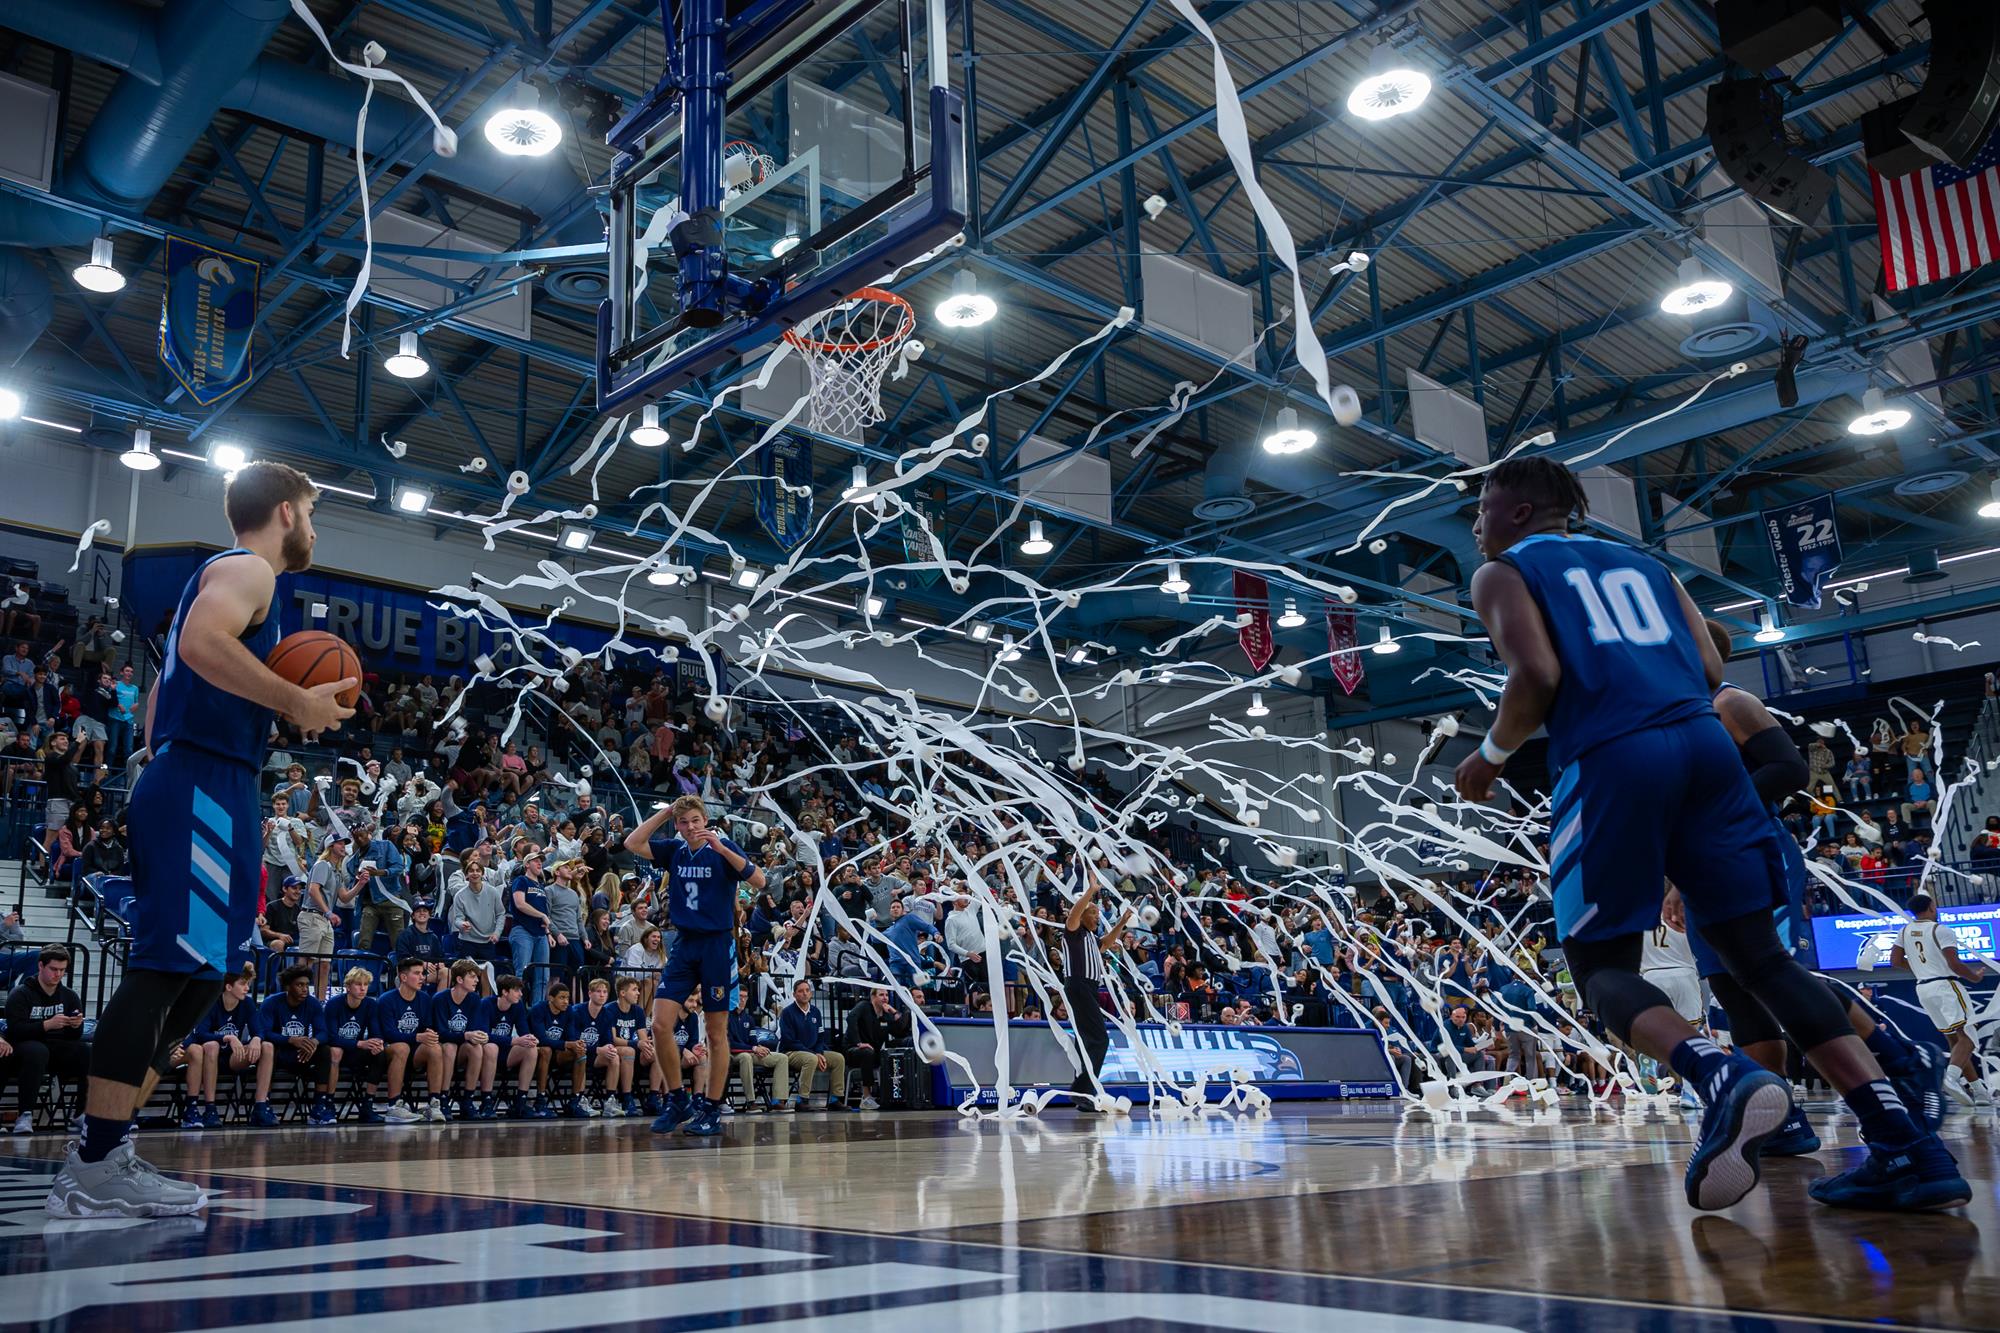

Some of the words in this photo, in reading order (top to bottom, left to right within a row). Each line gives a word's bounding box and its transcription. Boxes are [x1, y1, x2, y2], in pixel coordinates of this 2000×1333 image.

[210, 307, 226, 370] MAVERICKS
[775, 457, 785, 500] SOUERN
[776, 502, 786, 536] GEORGIA
[1797, 519, 1833, 547] 22
[1779, 553, 1795, 593] Chester
[294, 589, 421, 657] TRUE
[1563, 567, 1672, 646] 10
[681, 663, 706, 679] BUIL
[685, 882, 698, 910] 2
